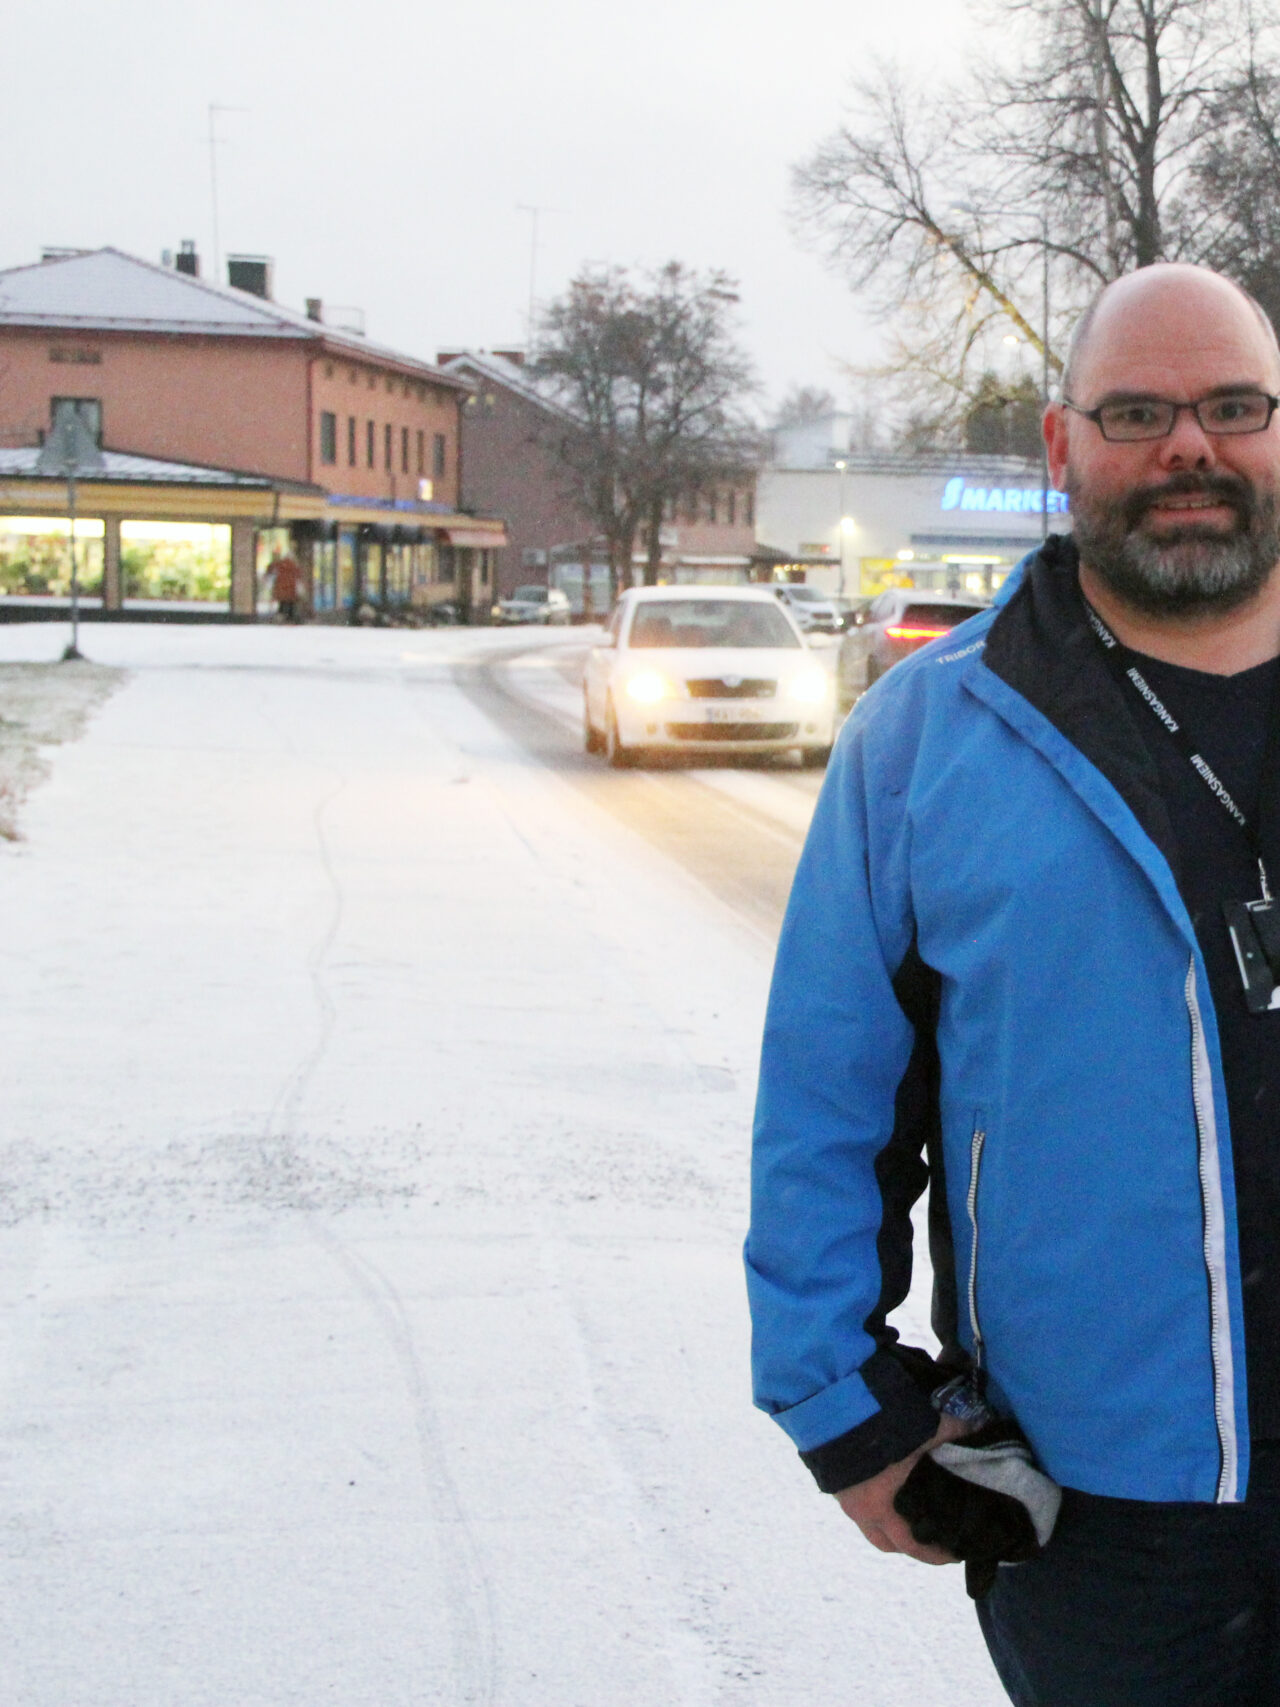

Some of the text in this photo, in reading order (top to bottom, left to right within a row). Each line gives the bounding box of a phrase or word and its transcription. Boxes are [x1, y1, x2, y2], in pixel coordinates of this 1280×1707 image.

[935, 640, 985, 665] TRIBOR
[1126, 667, 1179, 733] KANGASNIEMI
[1189, 753, 1246, 826] KANGASNIEMI
